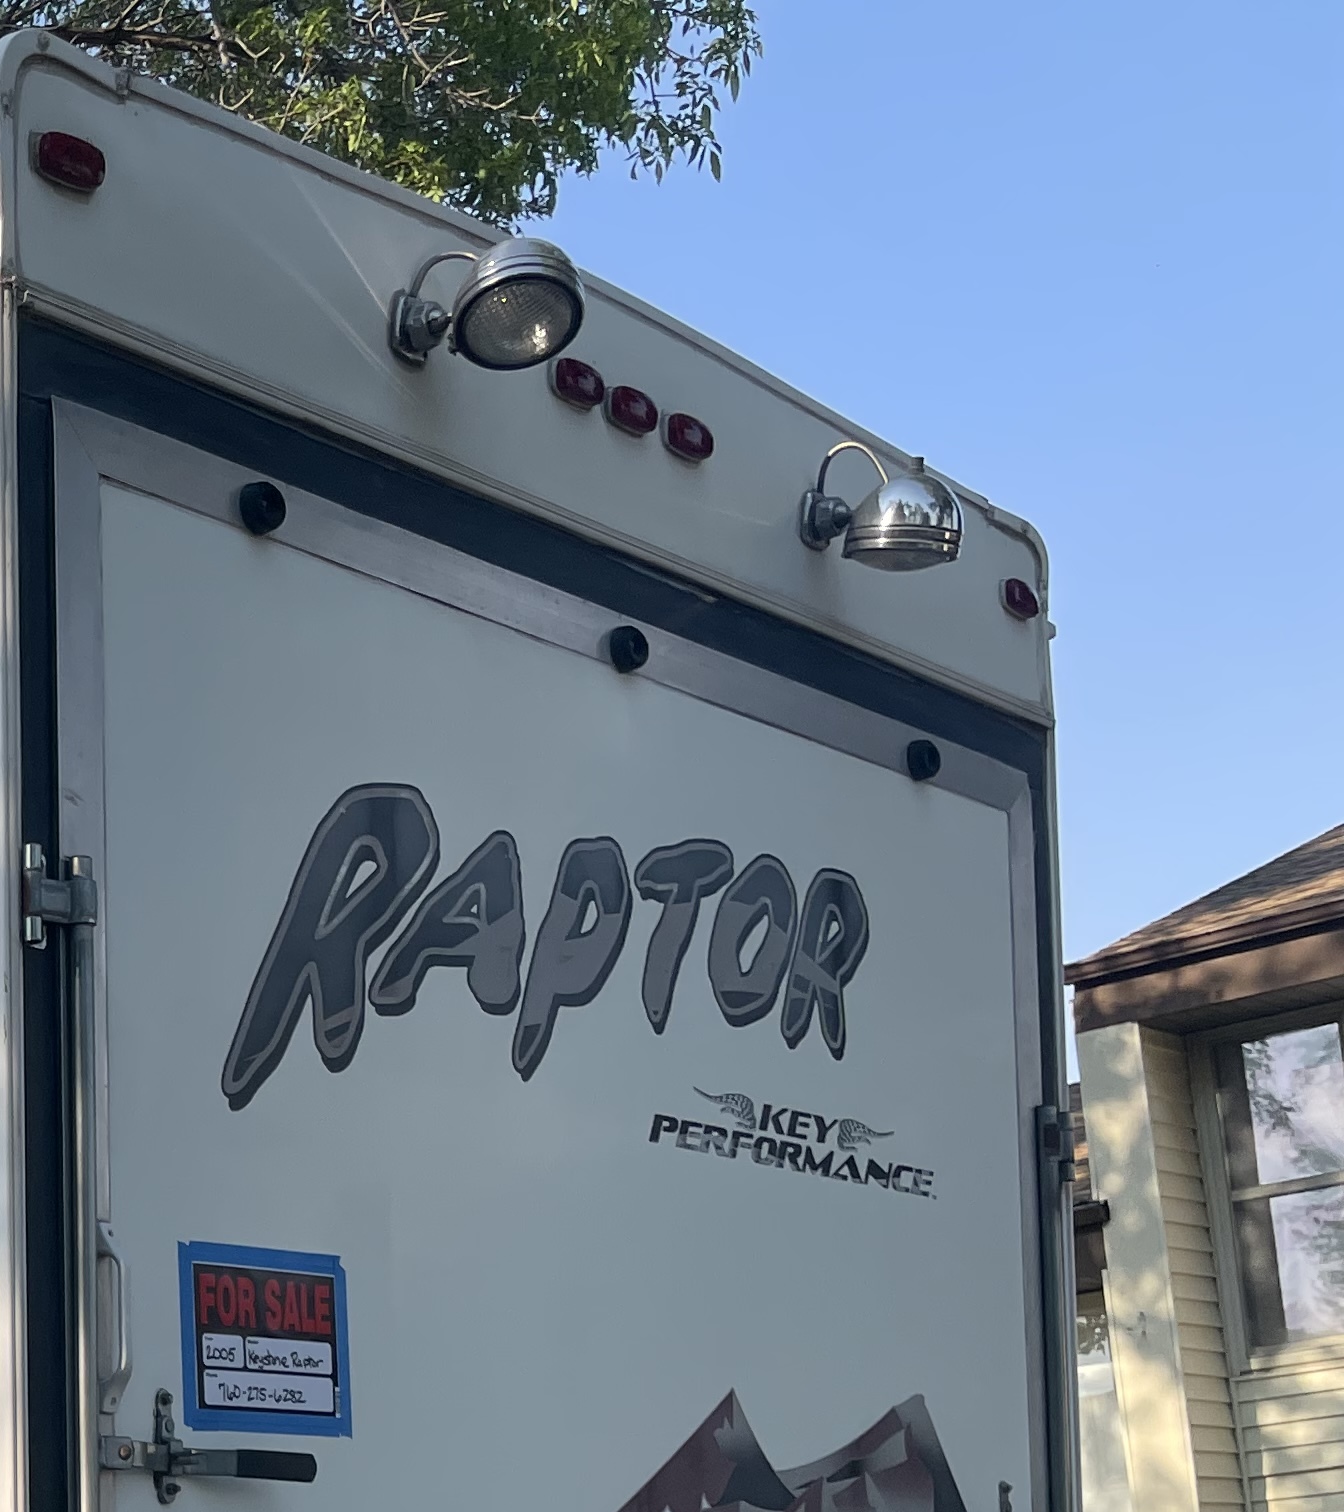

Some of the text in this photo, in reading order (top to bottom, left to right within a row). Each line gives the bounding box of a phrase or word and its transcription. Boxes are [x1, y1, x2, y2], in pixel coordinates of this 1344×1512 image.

[221, 782, 870, 1112] RAPTOR
[758, 1103, 839, 1144] KEY
[648, 1113, 935, 1198] PERFORMANCE
[198, 1273, 332, 1335] FOR SALE
[206, 1345, 237, 1363] 2005
